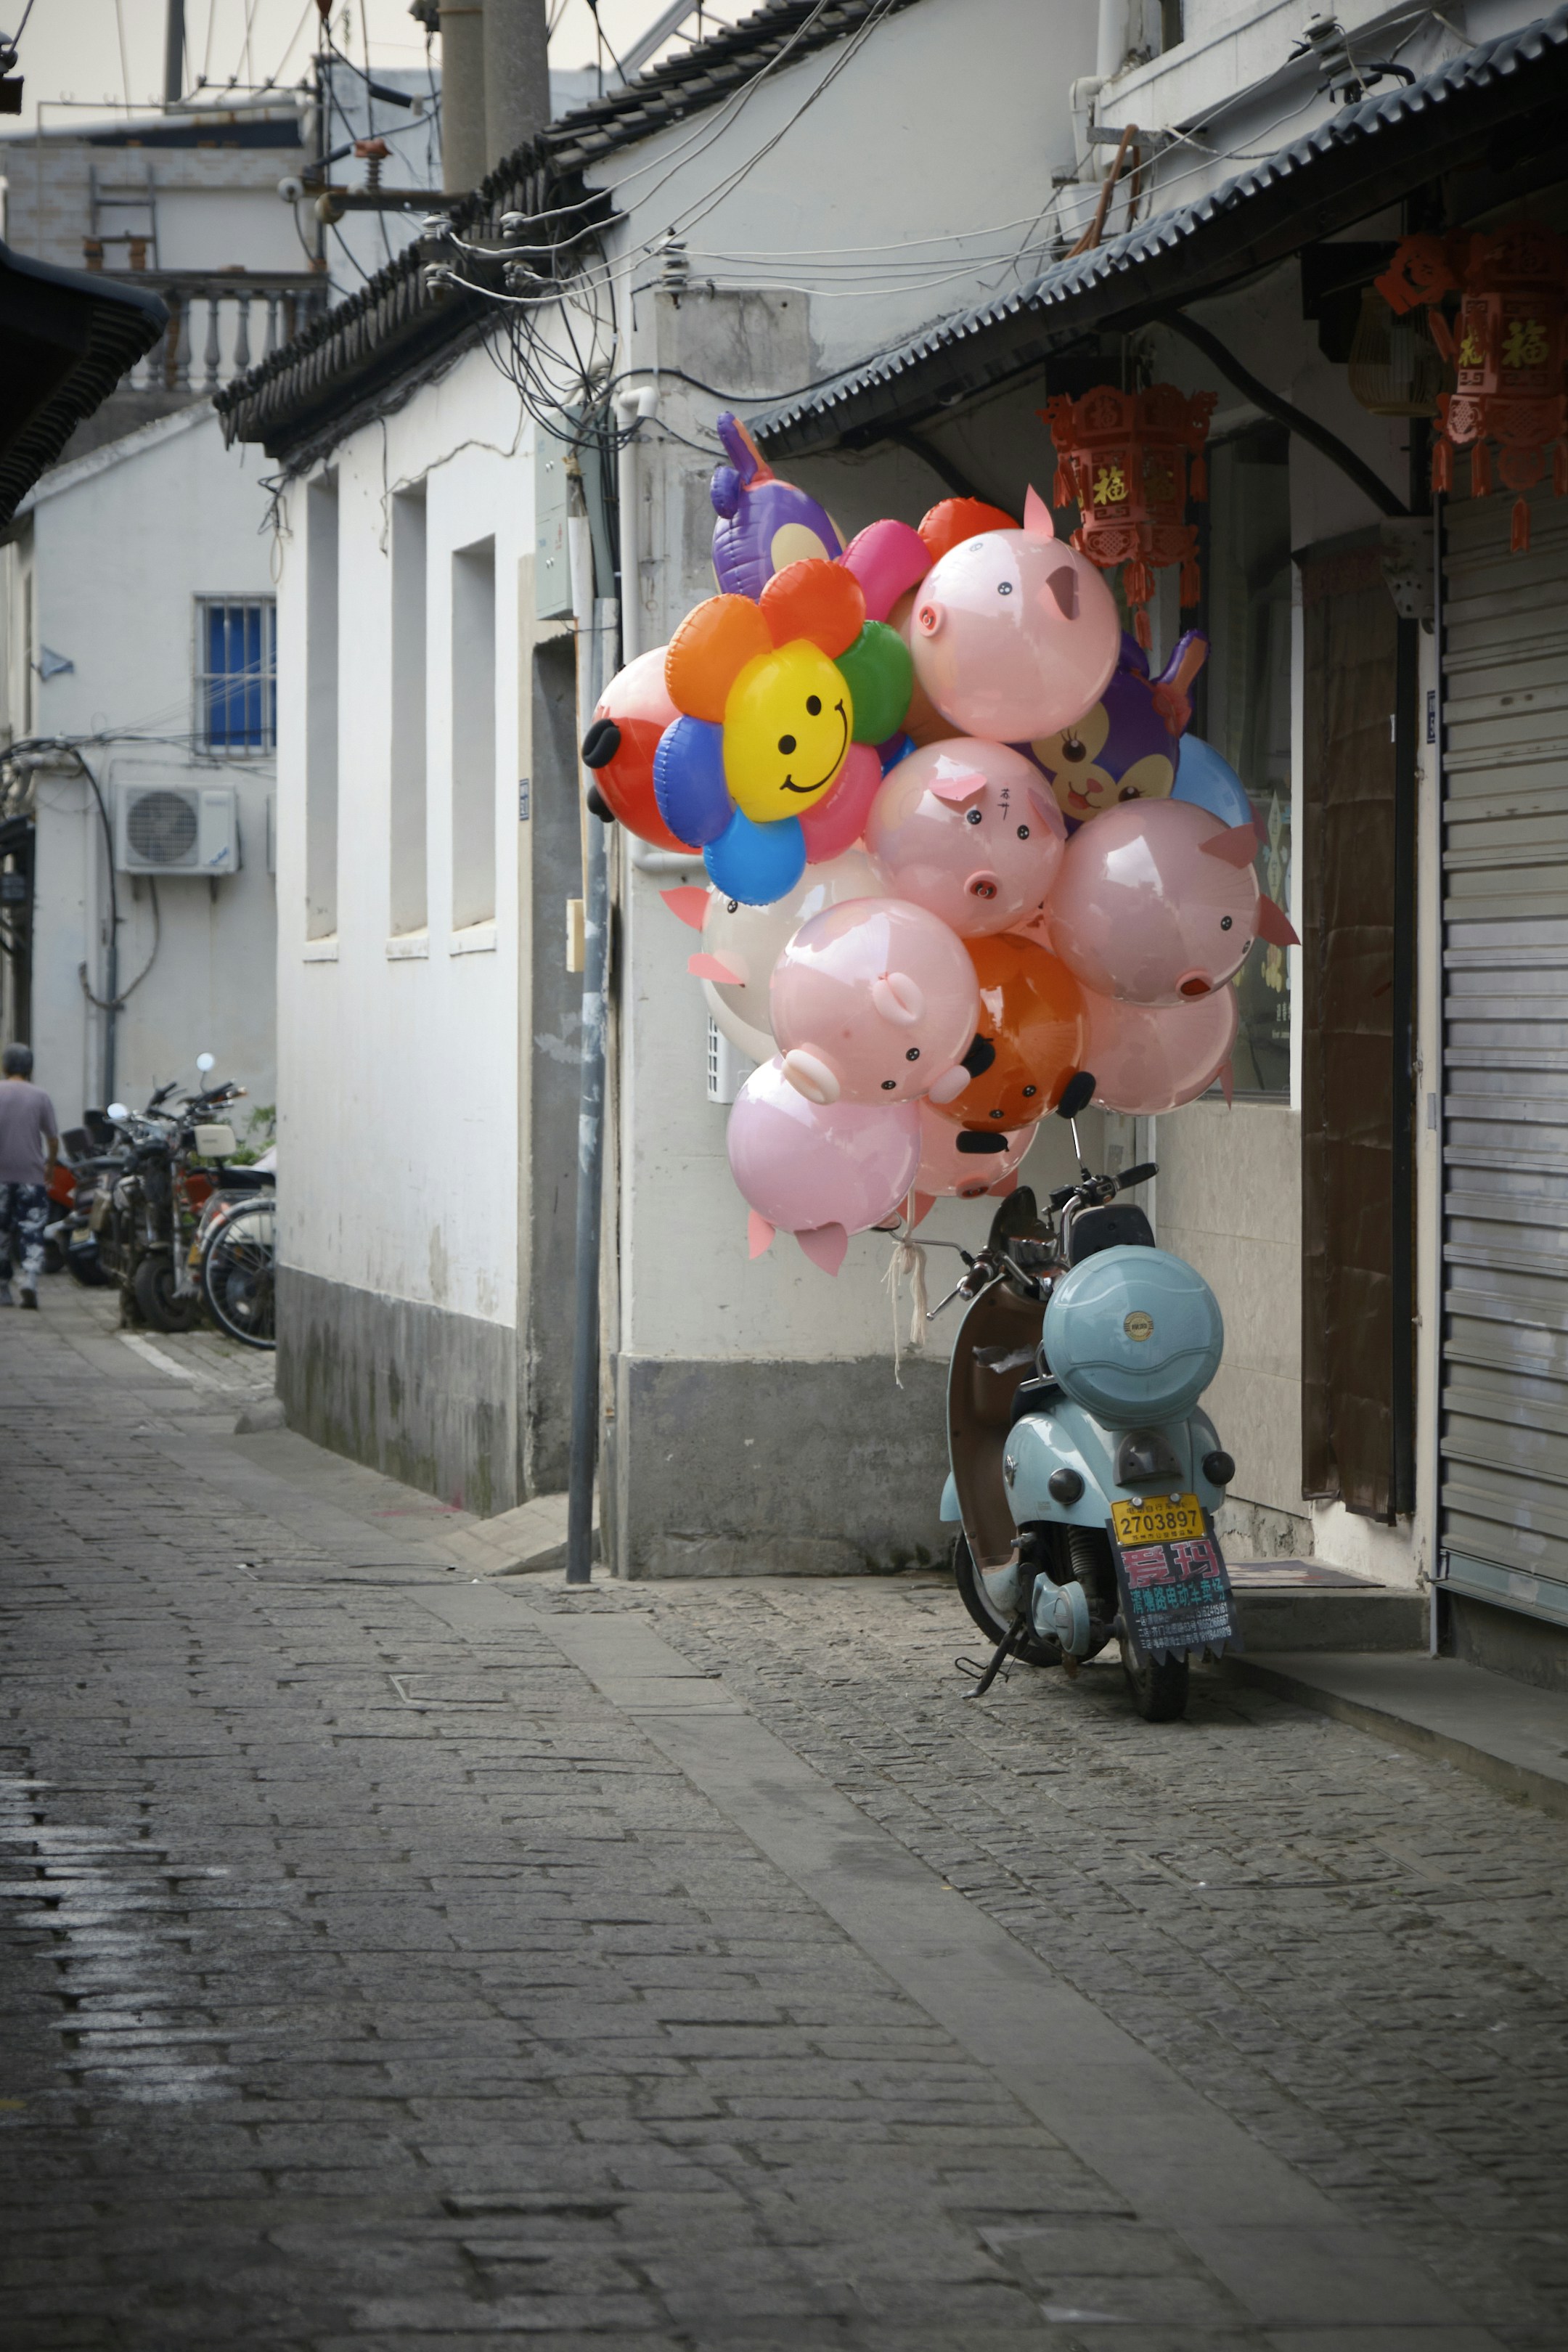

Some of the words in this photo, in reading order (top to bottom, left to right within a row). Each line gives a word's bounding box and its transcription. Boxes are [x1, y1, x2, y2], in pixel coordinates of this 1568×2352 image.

[1500, 319, 1551, 369] 福
[1093, 466, 1129, 505] 福
[1120, 1510, 1197, 1535] 2703897
[1121, 1539, 1220, 1589] 爱玛
